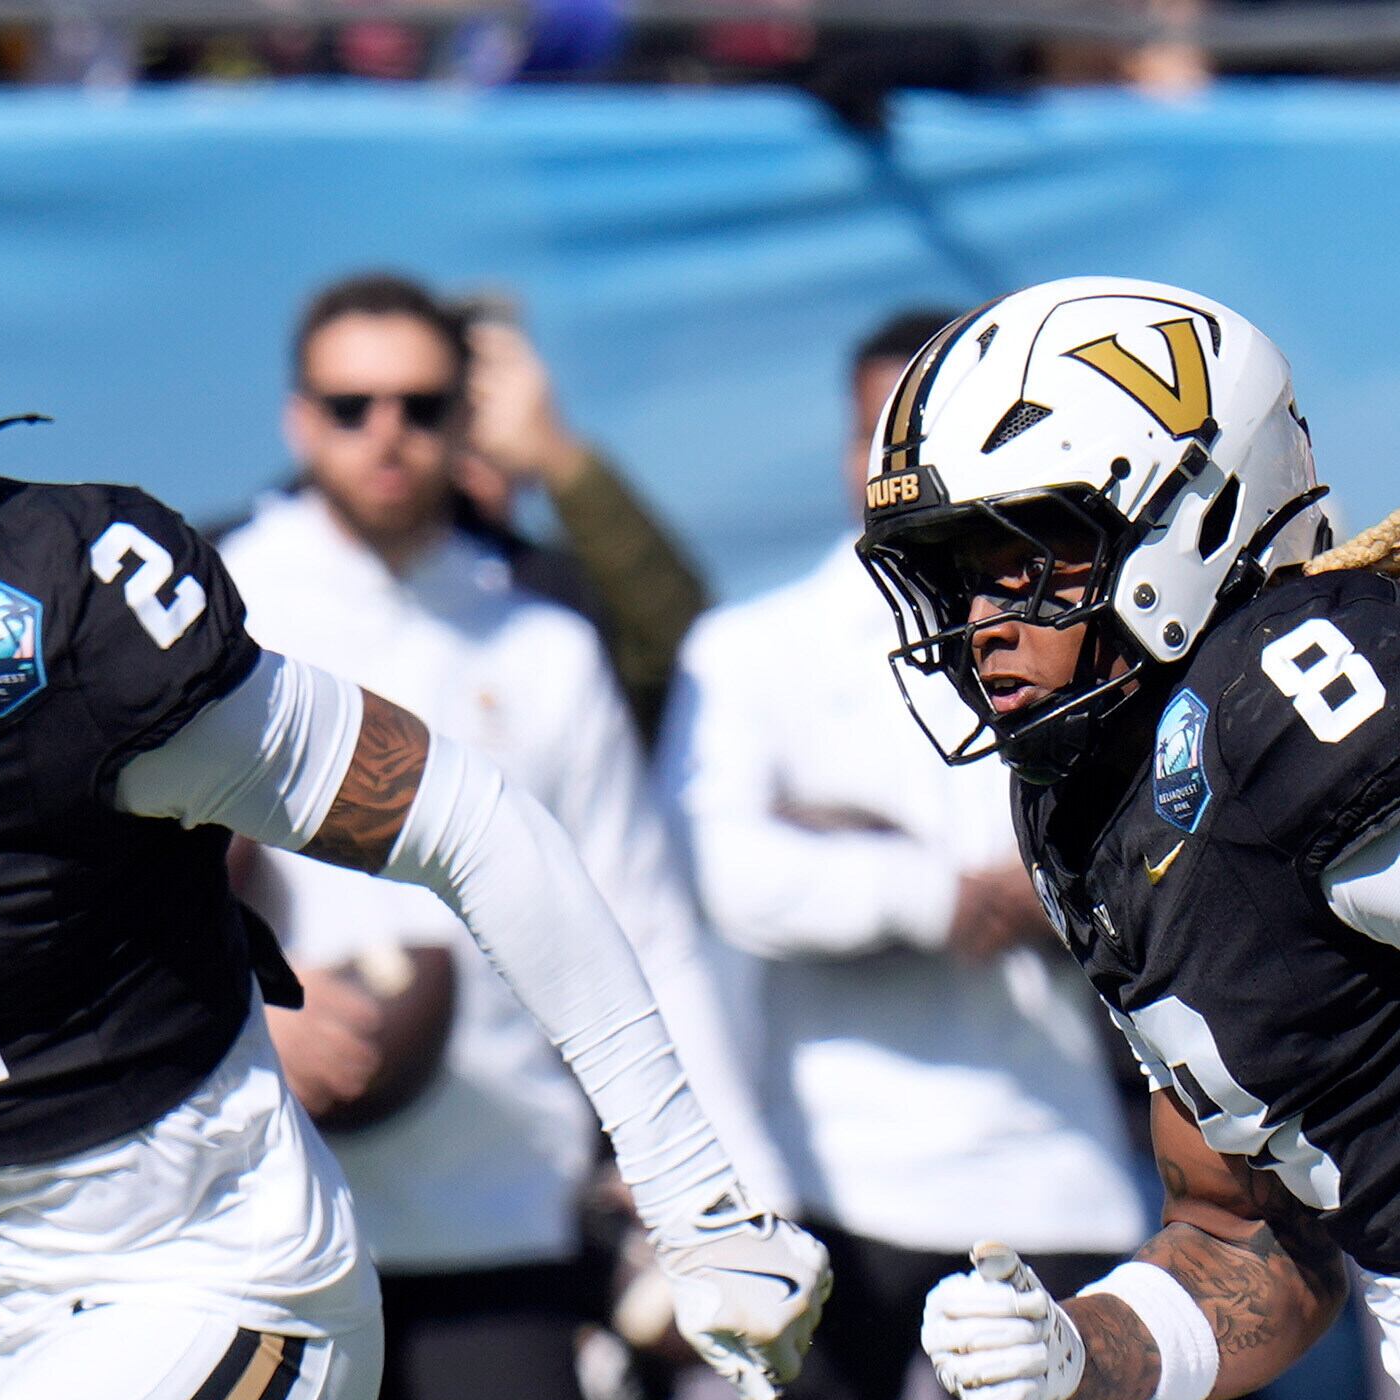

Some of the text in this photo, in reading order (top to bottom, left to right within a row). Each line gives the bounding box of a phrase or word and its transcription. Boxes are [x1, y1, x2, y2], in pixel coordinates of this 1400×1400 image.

[1059, 317, 1212, 441] V
[866, 473, 919, 509] VUFB
[90, 522, 208, 650] 2
[1261, 618, 1387, 743] 8
